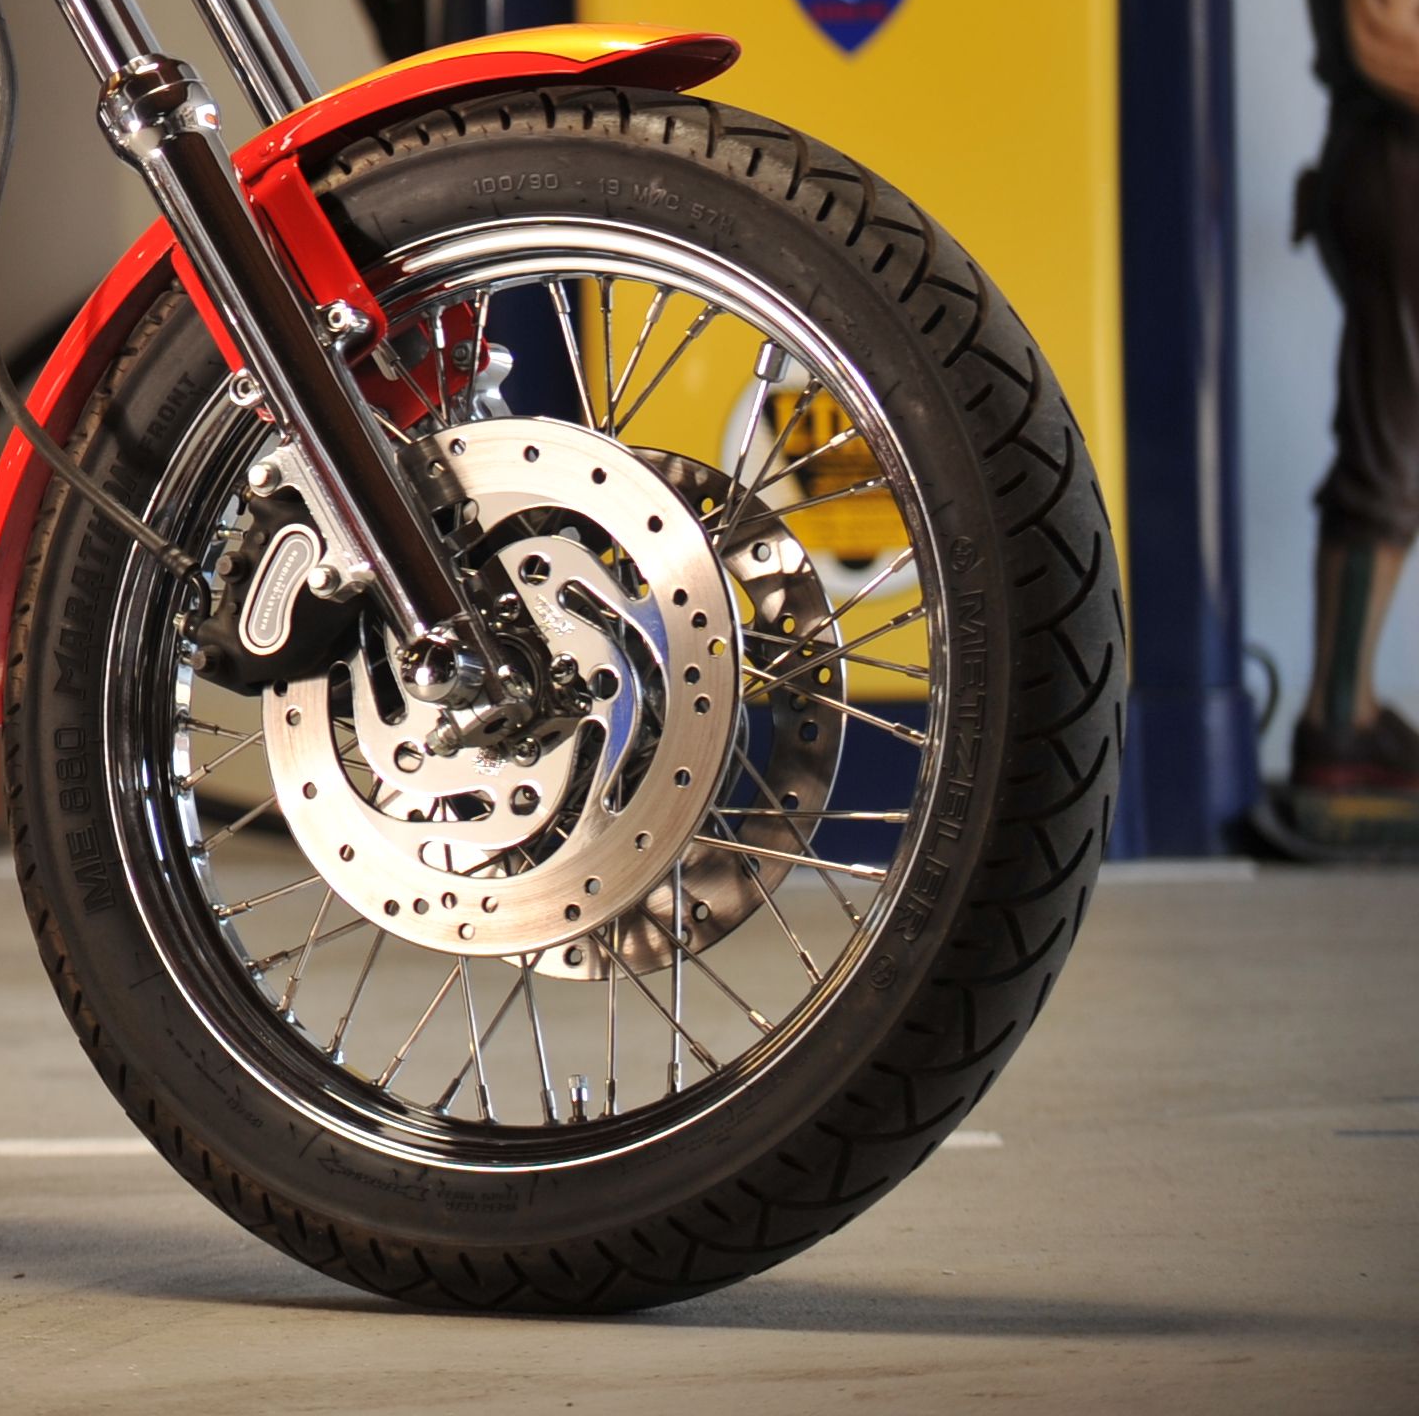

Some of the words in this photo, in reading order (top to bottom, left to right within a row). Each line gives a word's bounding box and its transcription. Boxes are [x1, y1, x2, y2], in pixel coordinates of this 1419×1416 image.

[472, 173, 559, 196] 100/90
[598, 177, 620, 197] 19
[142, 372, 197, 455] FRONT
[53, 726, 92, 815] 880
[893, 587, 988, 944] METZELER
[66, 824, 116, 916] ME
